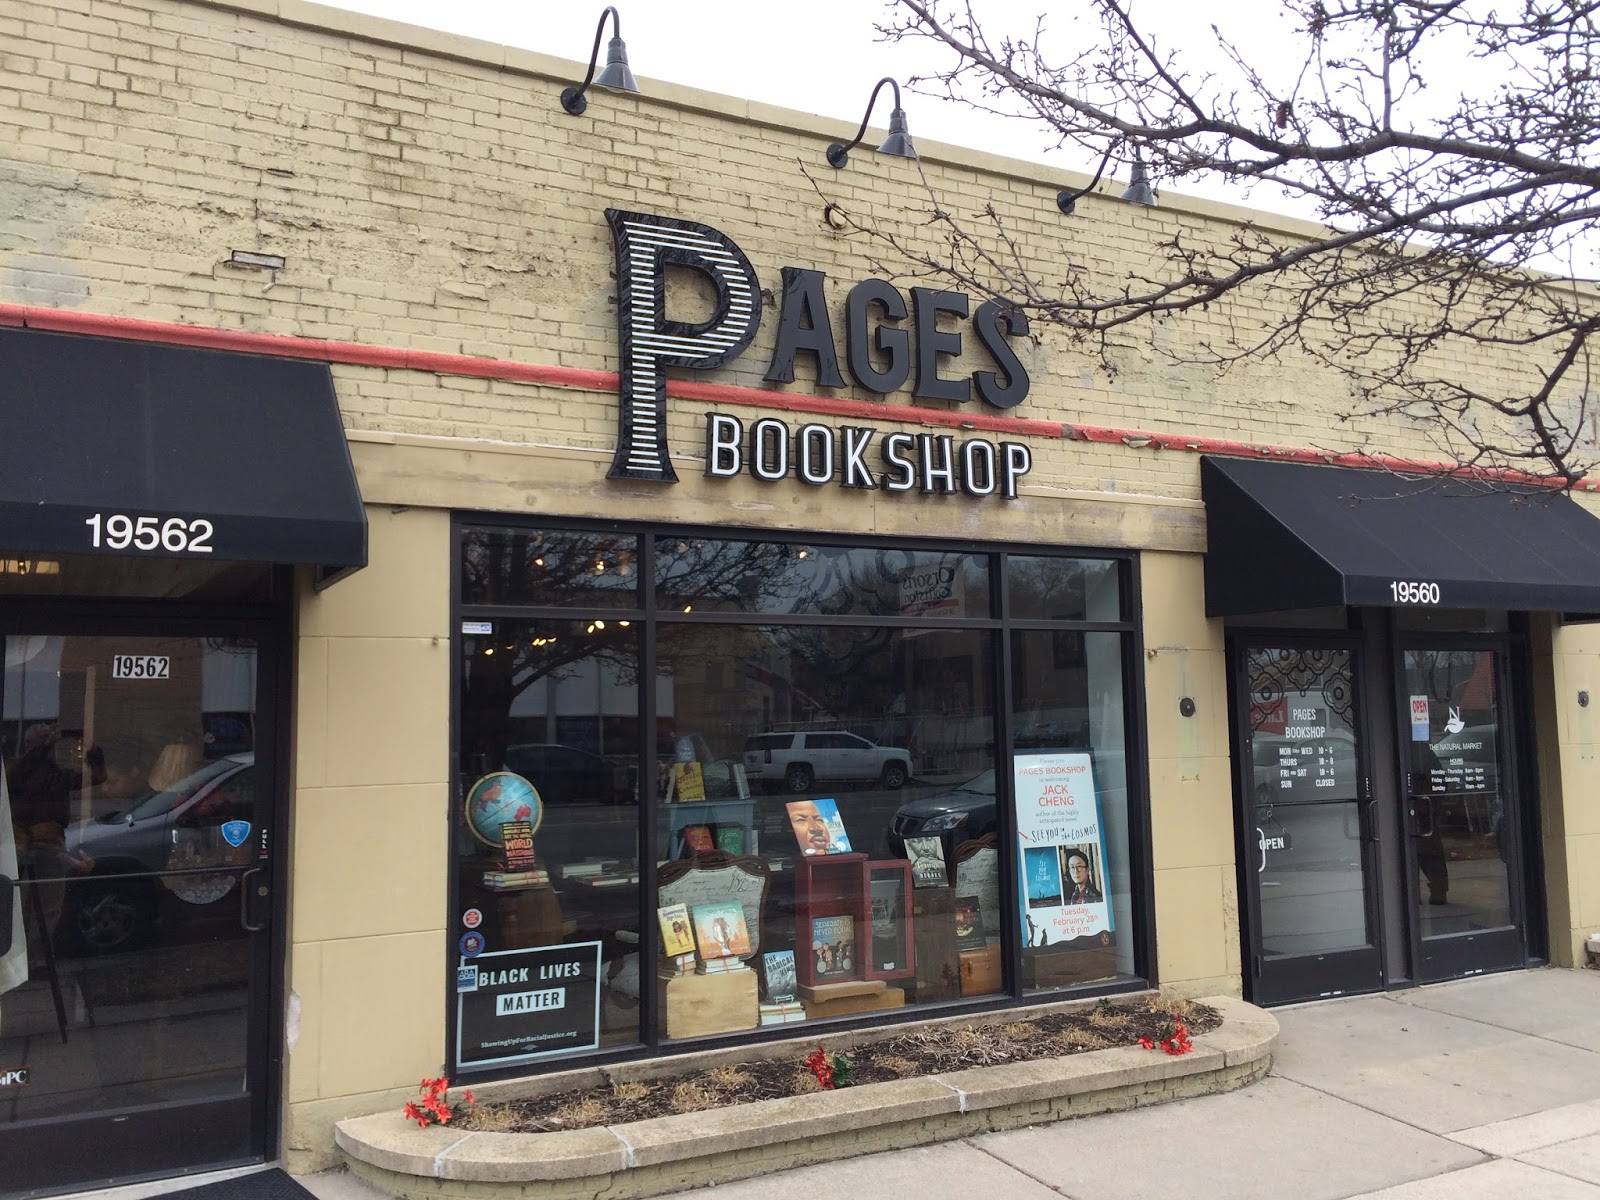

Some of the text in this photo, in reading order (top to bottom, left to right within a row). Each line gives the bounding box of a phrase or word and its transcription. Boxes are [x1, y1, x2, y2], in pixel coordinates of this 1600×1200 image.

[604, 208, 1030, 483] PAGES
[704, 412, 1032, 500] BOOKSHOP
[86, 513, 213, 552] 19562
[1390, 581, 1440, 604] 19560
[115, 656, 168, 677] 19562
[1412, 700, 1427, 713] OPEN
[1293, 708, 1317, 720] PAGES
[1285, 727, 1326, 738] BOOKSHOP
[1279, 747, 1292, 755] MON
[1301, 747, 1313, 755] WED
[1463, 742, 1482, 750] MARKET
[1280, 758, 1298, 766] THURS
[1319, 757, 1324, 765] 10
[1019, 766, 1086, 775] PAGES BOOKSHOP
[1280, 769, 1290, 777] FRI
[1319, 768, 1325, 776] 10
[1330, 768, 1334, 776] 6
[1281, 778, 1335, 788] SUN CLOSED
[1043, 784, 1068, 795] JACK
[1038, 796, 1075, 807] CHENG
[1032, 830, 1044, 843] SEE
[1045, 827, 1059, 841] YOU
[1071, 824, 1097, 840] COSMOS
[505, 839, 533, 850] WORLD
[1259, 837, 1285, 850] OPEN
[1061, 907, 1090, 915] Tuesday,
[1053, 917, 1085, 926] February
[1077, 927, 1091, 935] p.m.
[765, 954, 777, 966] THE
[768, 955, 794, 972] RADICAL
[479, 967, 529, 987] BLACK
[540, 962, 581, 980] LIVES
[780, 964, 795, 977] KING
[503, 992, 560, 1012] MATTER
[481, 1030, 578, 1048] ShowingUpForRacialJustice.org
